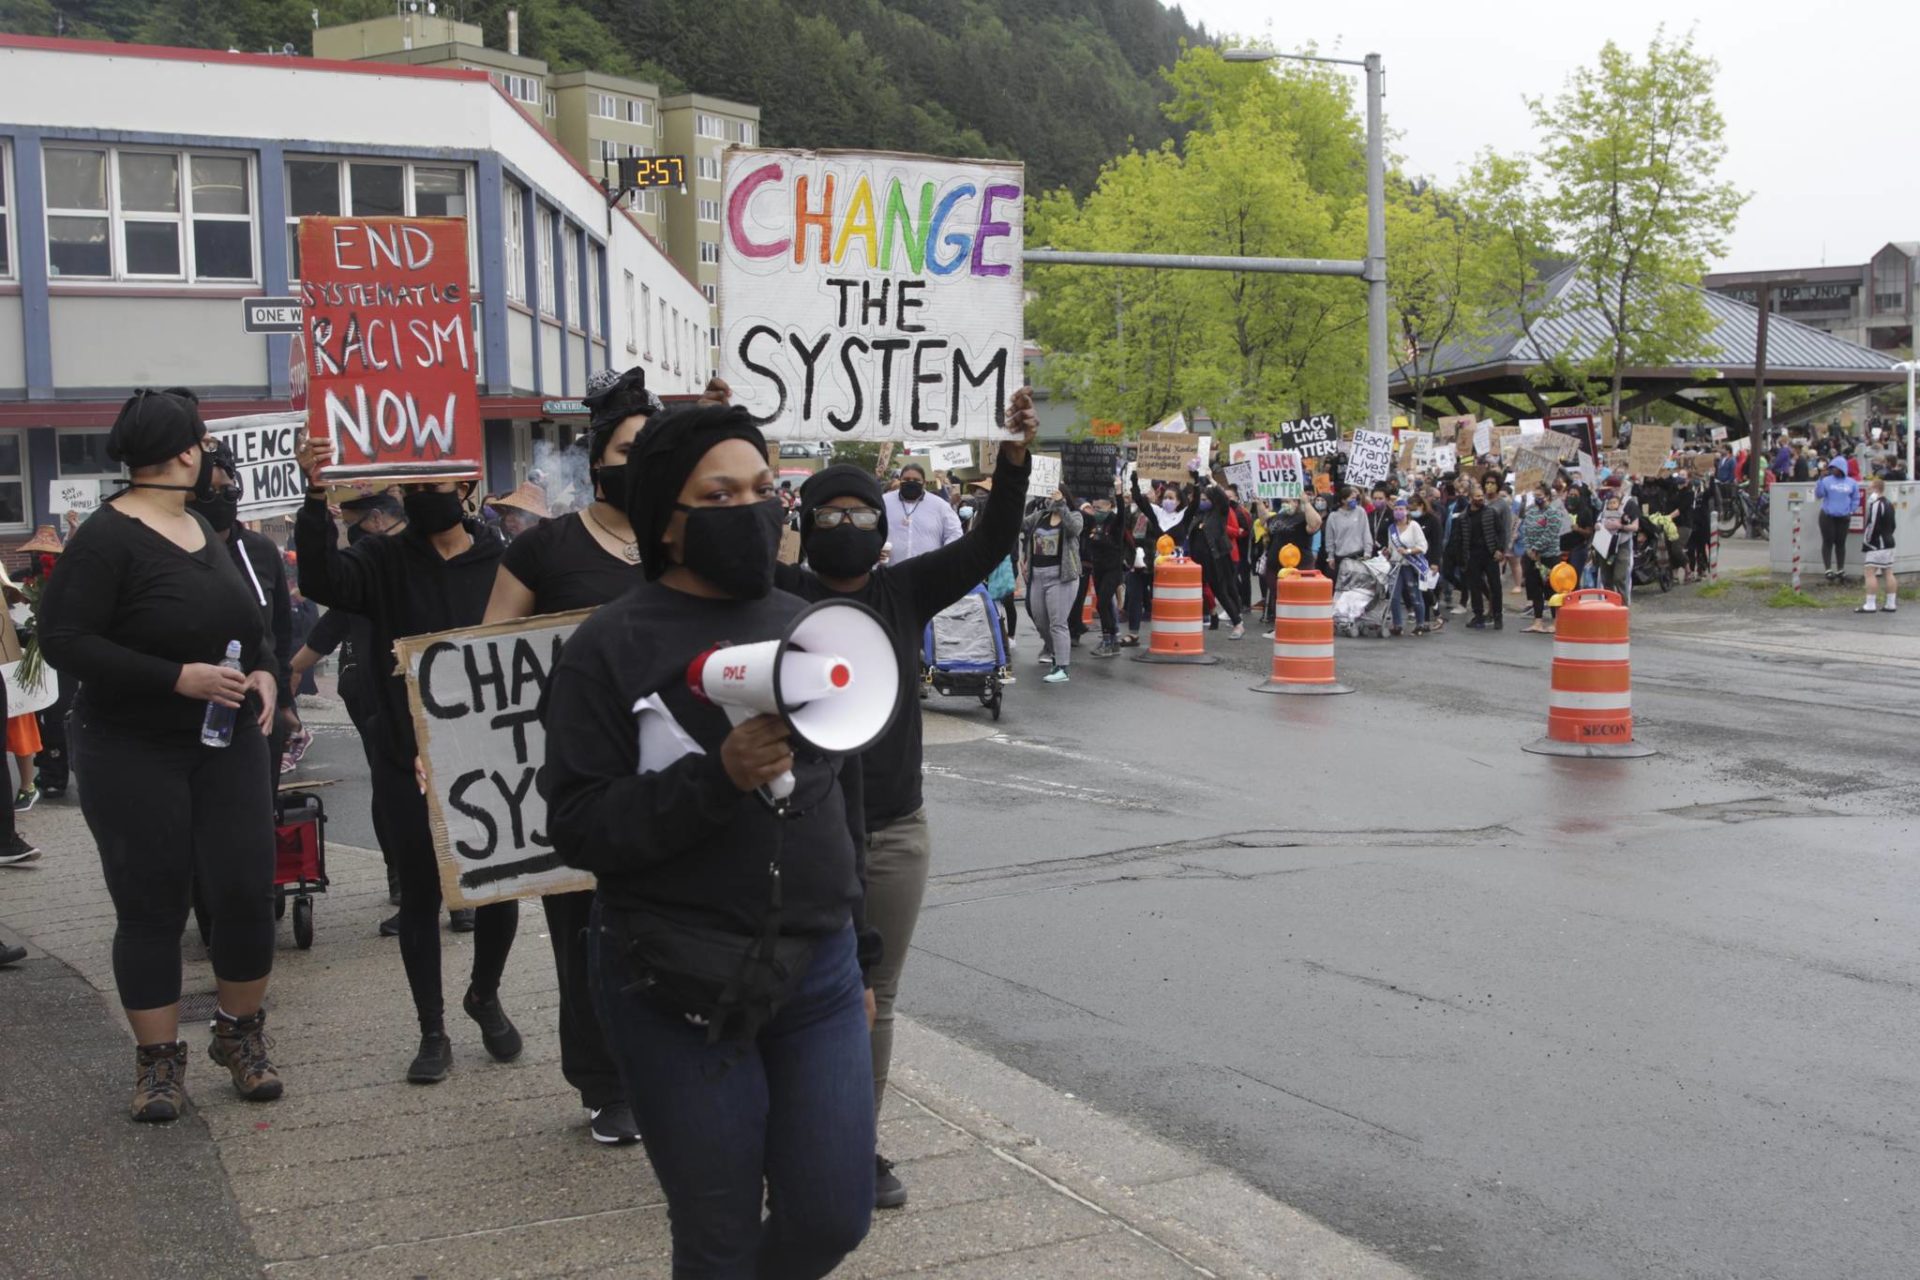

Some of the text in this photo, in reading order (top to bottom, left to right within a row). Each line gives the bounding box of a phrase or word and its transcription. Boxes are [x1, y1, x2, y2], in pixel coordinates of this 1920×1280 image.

[638, 158, 682, 185] 2:57
[728, 163, 1020, 276] CHANGE
[333, 224, 434, 269] END
[302, 281, 461, 307] SYSTEMATIC
[1780, 287, 1799, 299] UP
[256, 309, 285, 321] ONE
[826, 278, 926, 332] THE
[311, 312, 468, 375] RACISM
[738, 325, 1007, 431] SYSTEM
[325, 384, 457, 465] NOW
[1281, 415, 1334, 434] BLACK
[1293, 430, 1327, 444] LIVES
[1355, 430, 1391, 451] Black
[1283, 440, 1338, 457] ATTER!
[1353, 442, 1390, 464] Trans
[1257, 453, 1296, 470] BLACK
[1350, 455, 1387, 475] Lives
[1259, 469, 1297, 482] LIVES
[1346, 470, 1377, 487] Matt
[1257, 482, 1302, 497] MATTER
[418, 634, 564, 719] CHA
[723, 665, 746, 680] PYLE
